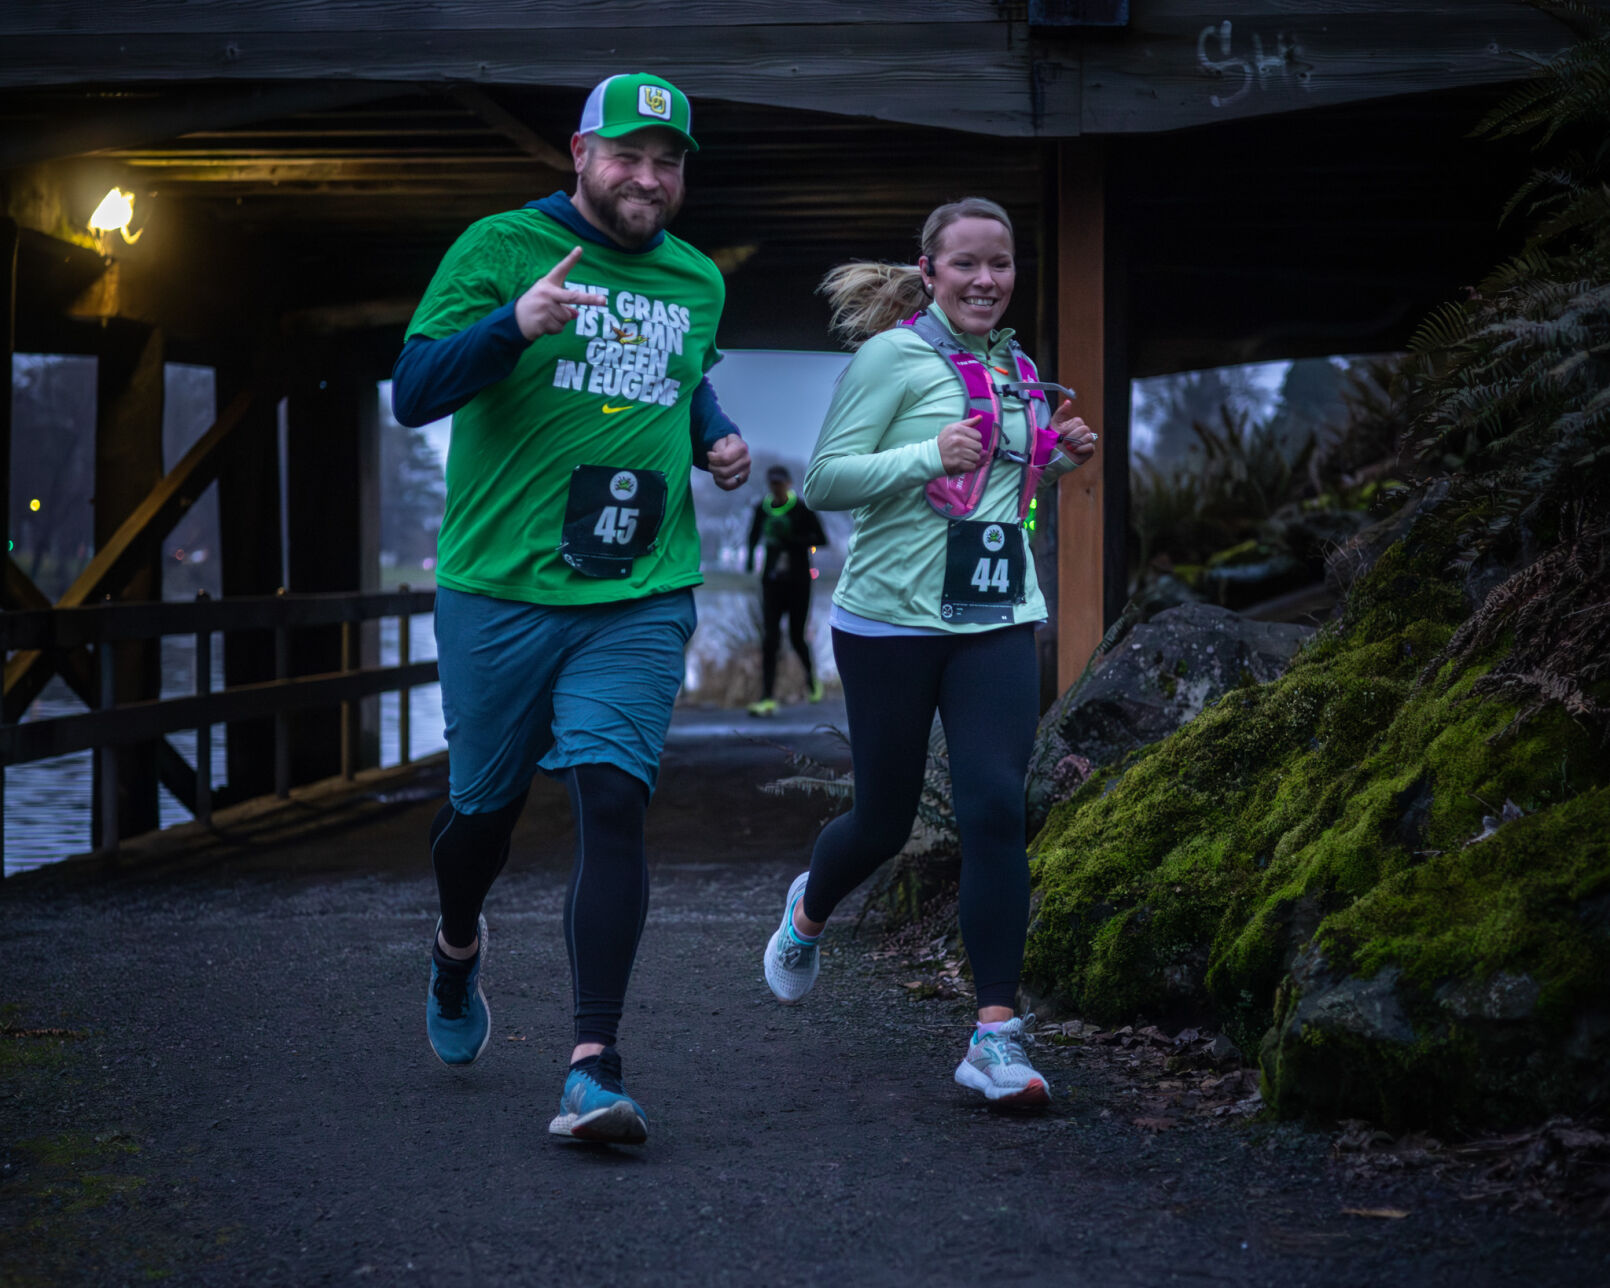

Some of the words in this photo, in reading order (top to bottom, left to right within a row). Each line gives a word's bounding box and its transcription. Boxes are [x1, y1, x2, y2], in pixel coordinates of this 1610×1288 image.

[575, 307, 599, 337] IS
[616, 291, 690, 333] GRASS
[586, 337, 669, 378] GREEN
[552, 359, 587, 391] IN
[587, 364, 681, 407] EUGENE
[593, 505, 640, 545] 45
[970, 557, 1010, 593] 44
